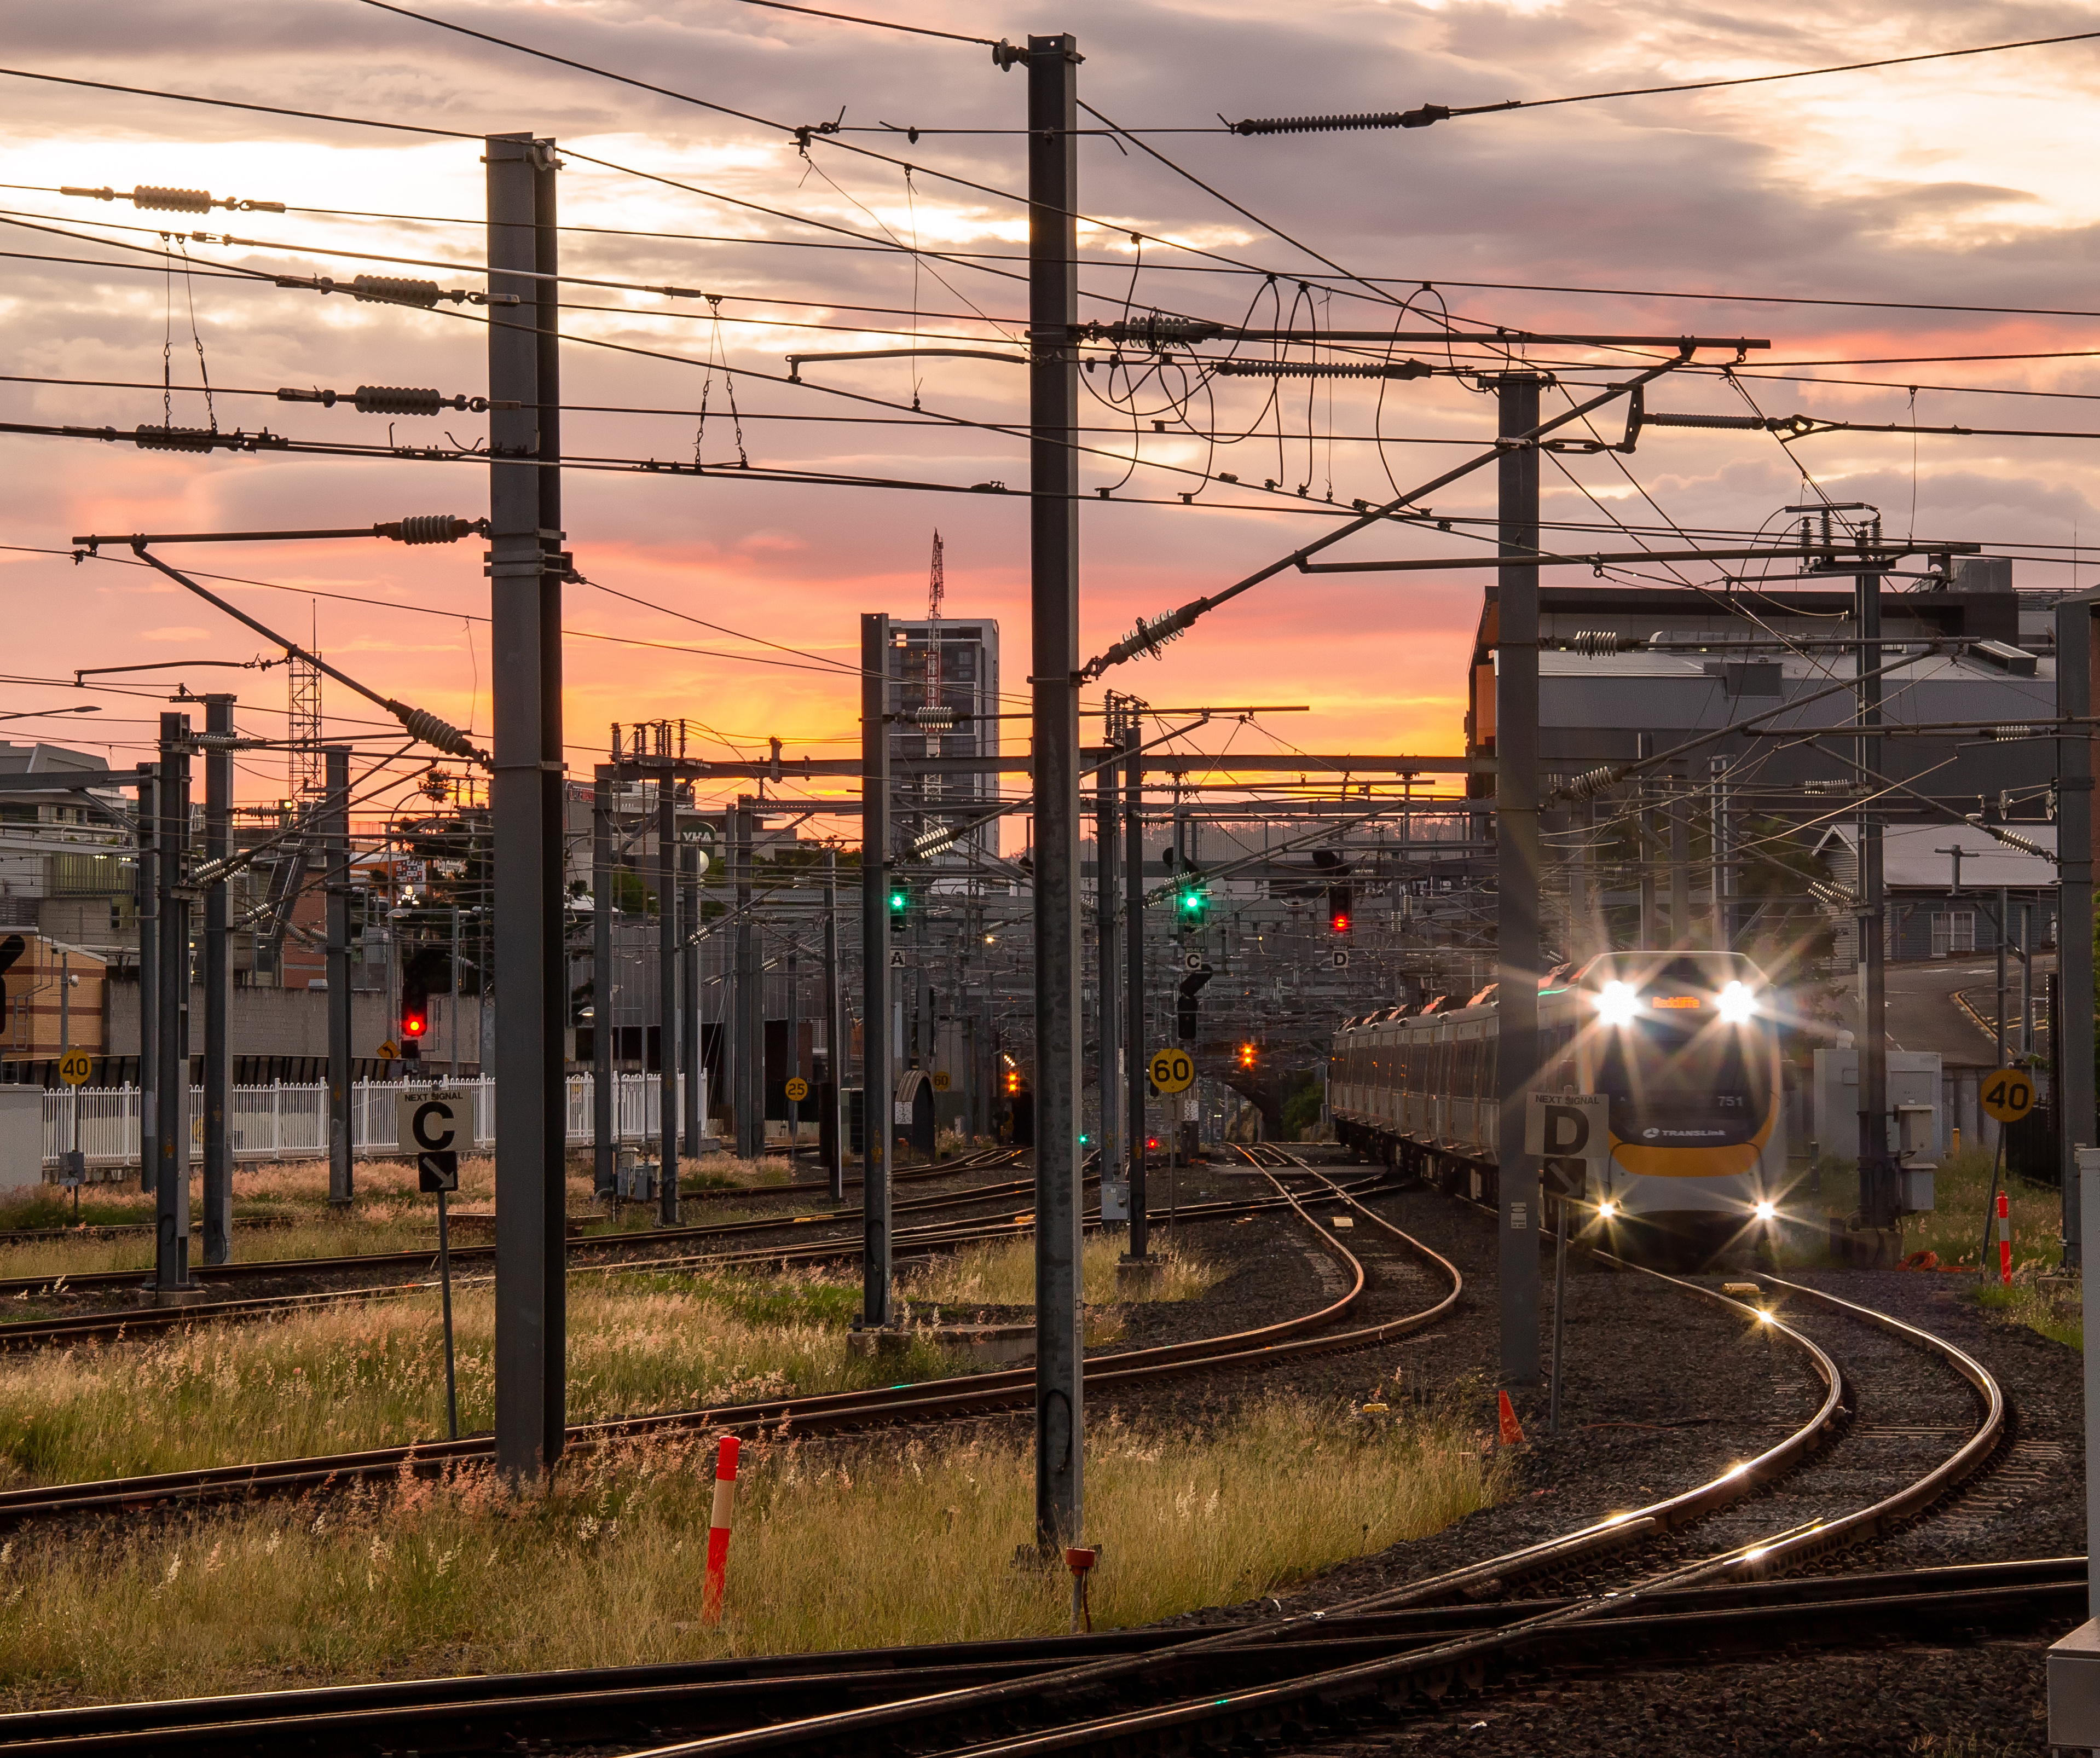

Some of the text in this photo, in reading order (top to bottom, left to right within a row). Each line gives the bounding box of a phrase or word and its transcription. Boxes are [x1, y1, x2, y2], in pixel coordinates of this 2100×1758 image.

[890, 951, 904, 965] A
[1187, 953, 1200, 969] C
[1334, 952, 1347, 966] D
[1652, 996, 1700, 1009] Redcliffe
[62, 1057, 88, 1077] 40
[1154, 1057, 1189, 1083] 60
[934, 1075, 948, 1086] 60
[404, 1091, 464, 1102] NEXT SIGNAL
[788, 1083, 805, 1096] 25
[1986, 1080, 2029, 1111] 40
[1535, 1095, 1600, 1105] NEXT SIGNAL
[1717, 1096, 1744, 1107] 751
[412, 1101, 455, 1150] C
[1543, 1104, 1589, 1156] D
